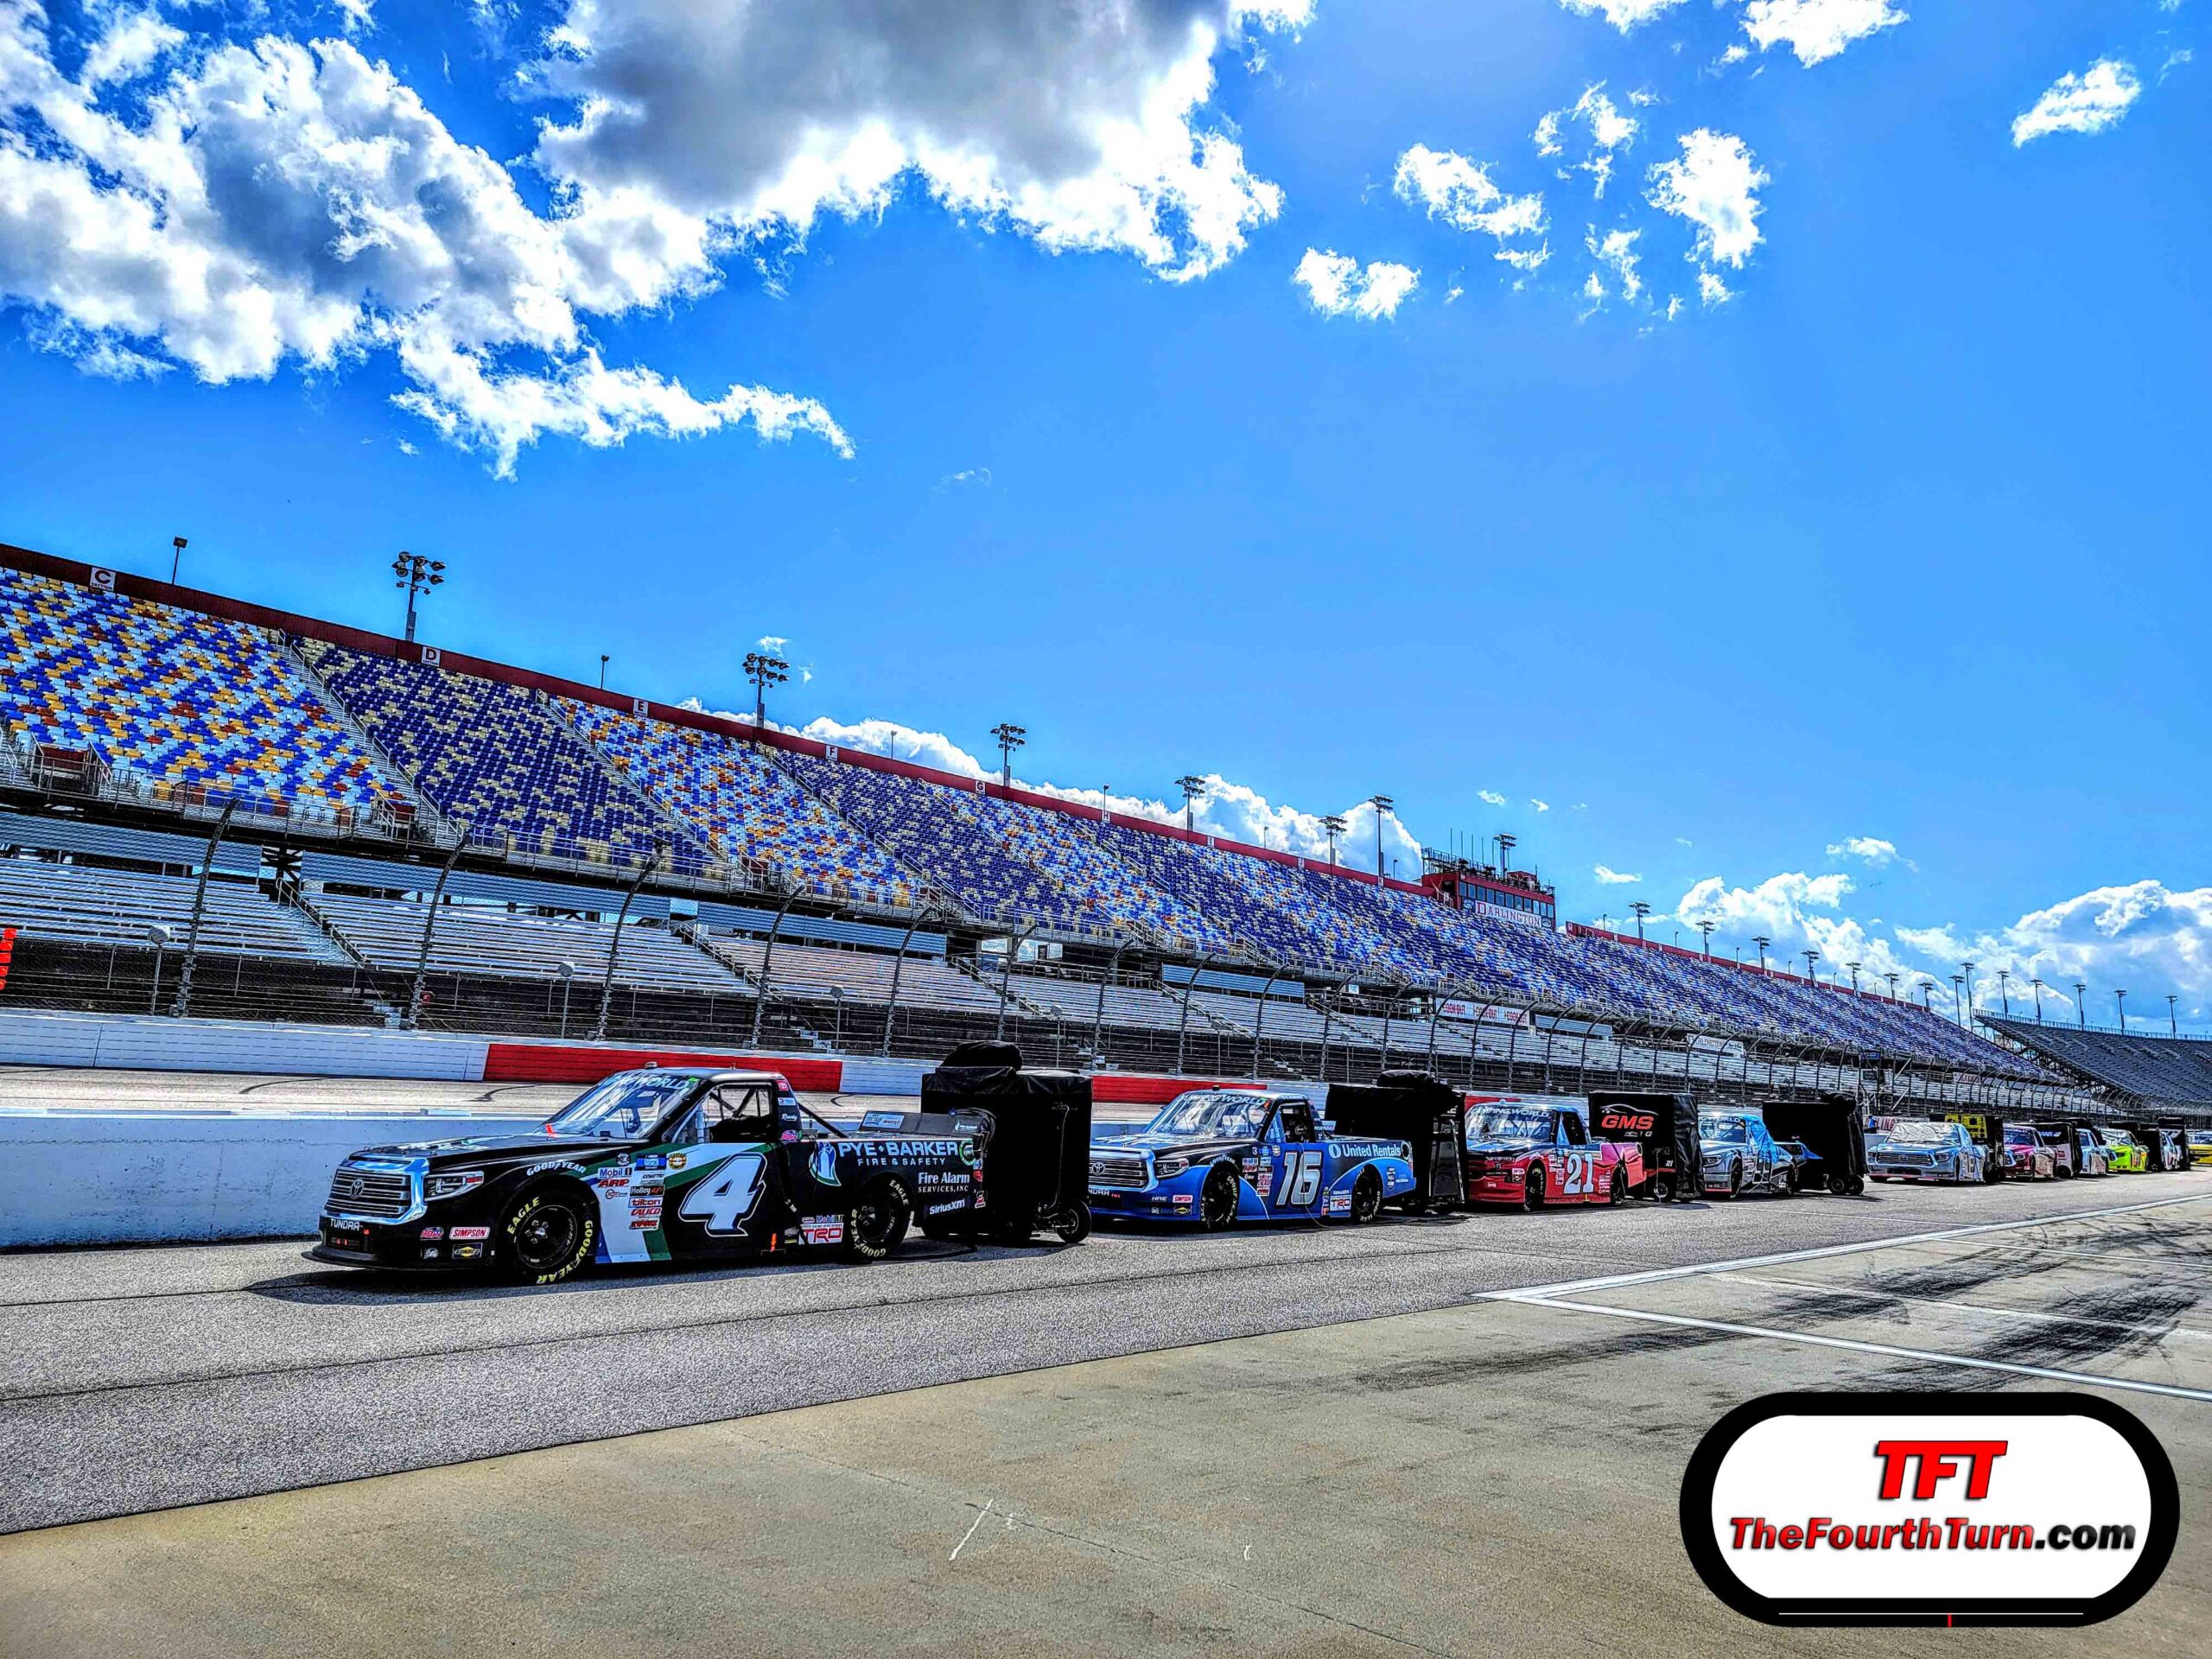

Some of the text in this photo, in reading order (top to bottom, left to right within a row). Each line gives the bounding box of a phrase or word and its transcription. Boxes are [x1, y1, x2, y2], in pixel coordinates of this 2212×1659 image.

[94, 570, 111, 584] C
[426, 648, 437, 660] D
[638, 700, 645, 712] E
[830, 747, 836, 756] F
[976, 781, 984, 791] G
[1477, 901, 1541, 927] DARLINGTON
[639, 1077, 689, 1090] WORLD
[1224, 1095, 1267, 1105] WORLD
[1471, 1107, 1549, 1118] CAMPING WORLD
[1601, 1115, 1654, 1130] GMS
[1342, 1143, 1402, 1157] United Rentals
[526, 1160, 588, 1176] GOODYEAR
[857, 1158, 887, 1166] FIRE
[902, 1157, 946, 1166] SAFETY
[600, 1168, 622, 1177] Mobil
[918, 1172, 970, 1185] Fire Alarm
[1276, 1151, 1322, 1206] 16
[1564, 1152, 1595, 1194] 21
[599, 1179, 629, 1188] ARP
[678, 1152, 767, 1236] 4
[889, 1179, 910, 1206] EAGLE
[1088, 1187, 1110, 1196] NDRA
[1332, 1198, 1351, 1209] TRD
[507, 1197, 540, 1236] EAGLE
[330, 1217, 360, 1231] TUNDRA
[453, 1229, 486, 1237] SIMPSON
[803, 1228, 842, 1243] TRD
[851, 1209, 887, 1258] GOODYEAR
[536, 1220, 594, 1285] GOODYEAR
